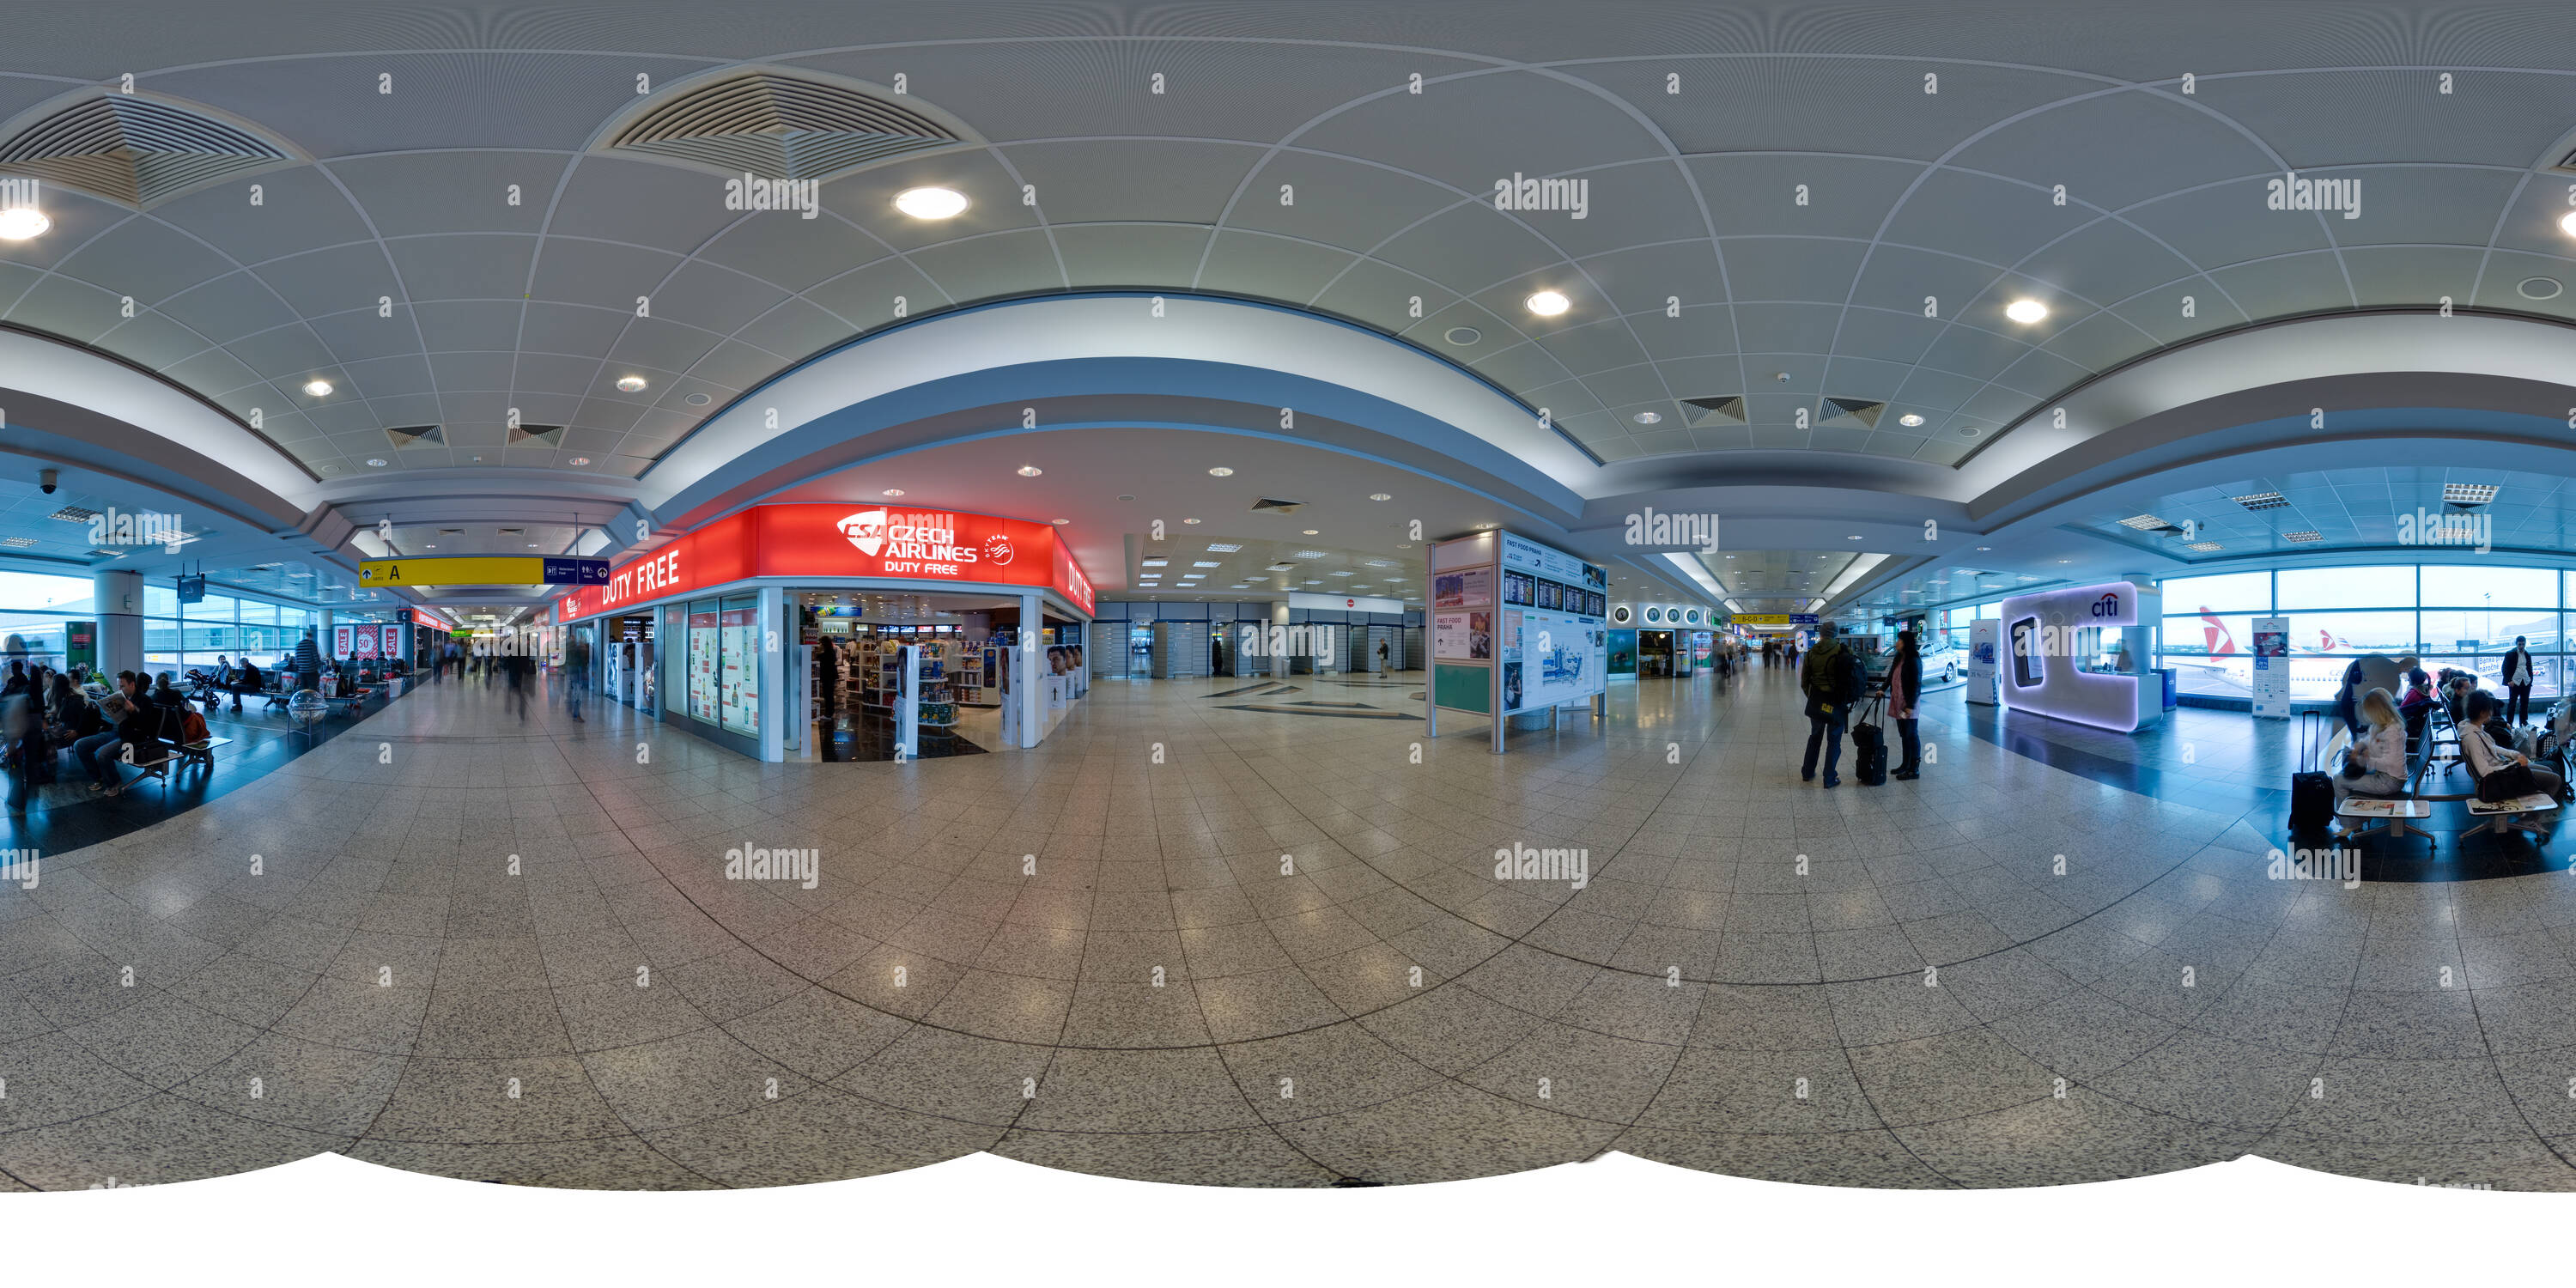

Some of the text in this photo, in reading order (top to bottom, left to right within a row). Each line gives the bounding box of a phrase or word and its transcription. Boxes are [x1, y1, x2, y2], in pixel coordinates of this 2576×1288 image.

[888, 526, 955, 545] CZECH
[984, 533, 1007, 558] SKYTEAM
[1506, 539, 1517, 549] FAST
[1518, 543, 1528, 552] FOOD
[884, 542, 977, 563] AIRLINES
[389, 565, 400, 580] A
[603, 550, 679, 605] DUTY FREE
[885, 561, 958, 575] DUTY FREE
[1068, 560, 1082, 601] DUTY
[2092, 594, 2117, 617] citi
